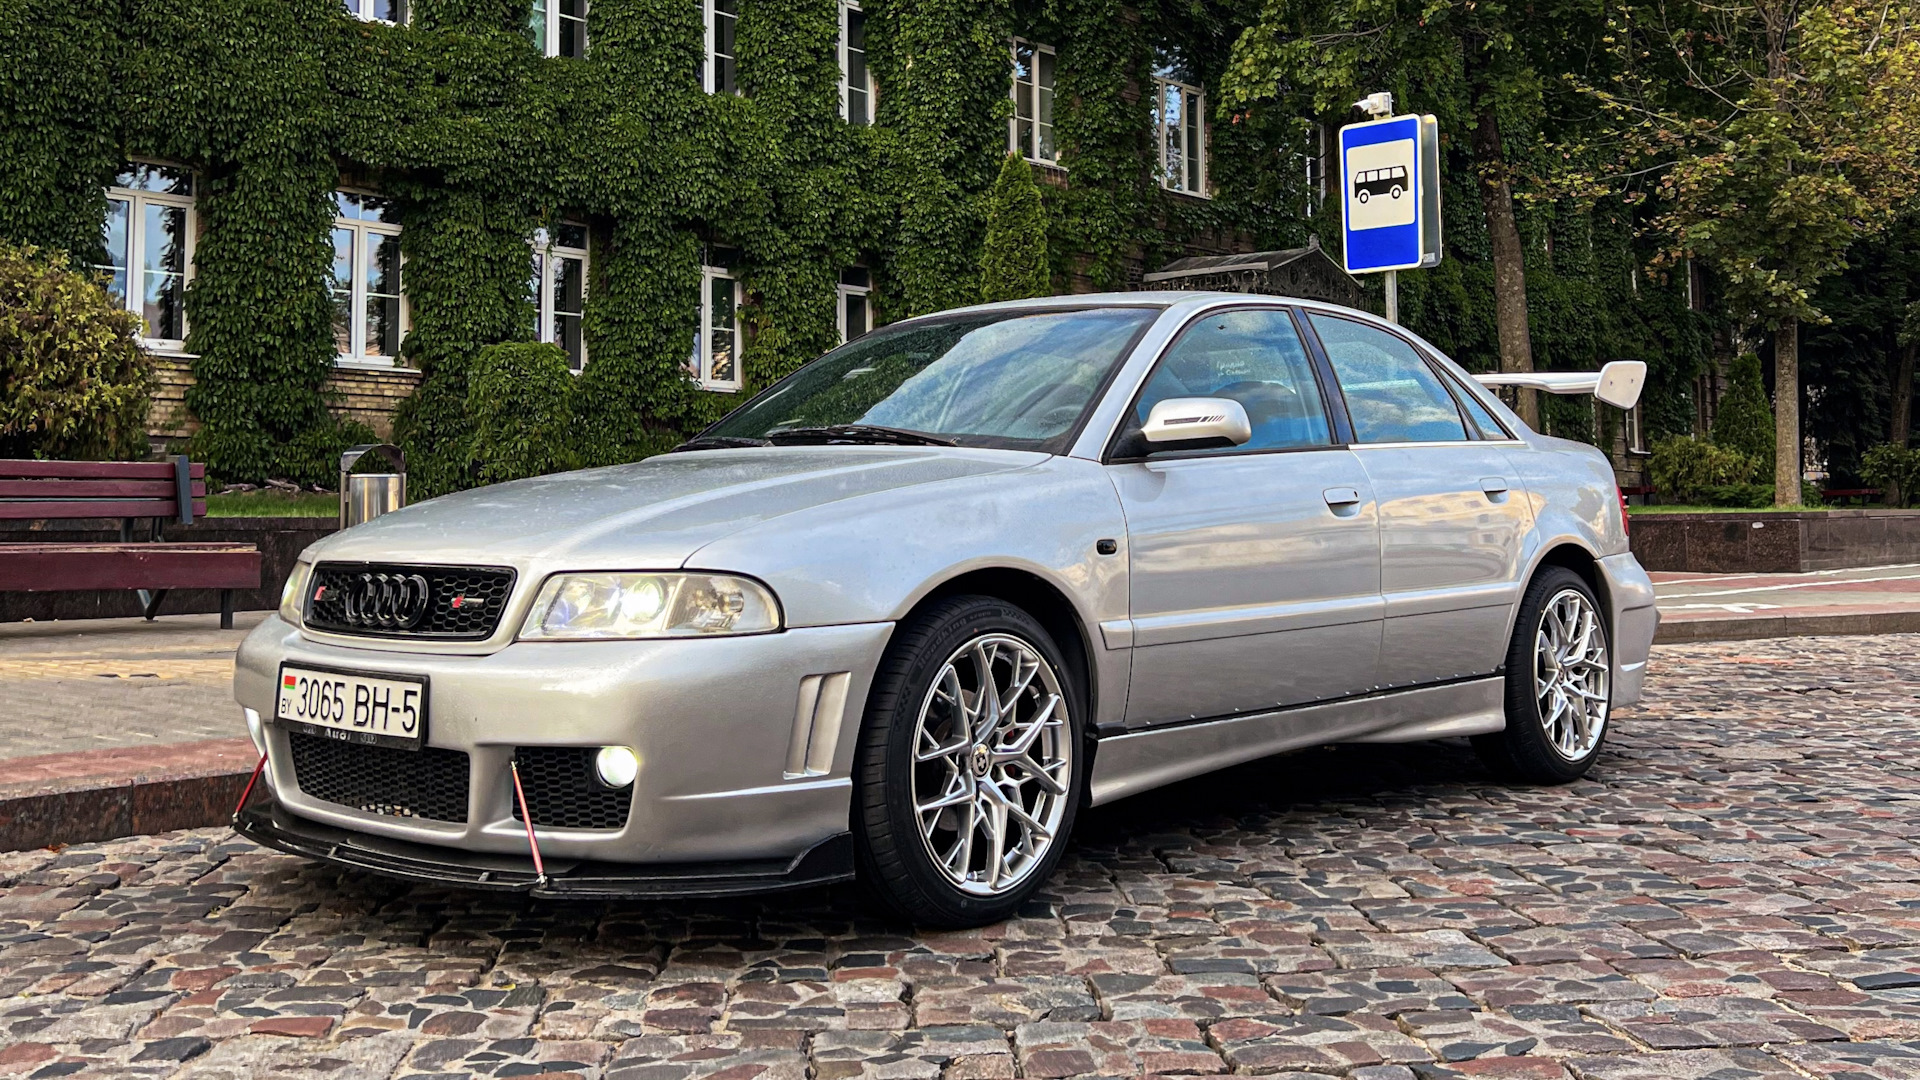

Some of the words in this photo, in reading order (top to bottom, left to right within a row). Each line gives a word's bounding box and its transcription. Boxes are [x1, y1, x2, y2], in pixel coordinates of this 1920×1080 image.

[280, 698, 292, 714] BY
[297, 677, 346, 723] 3065
[353, 684, 418, 732] BH-5
